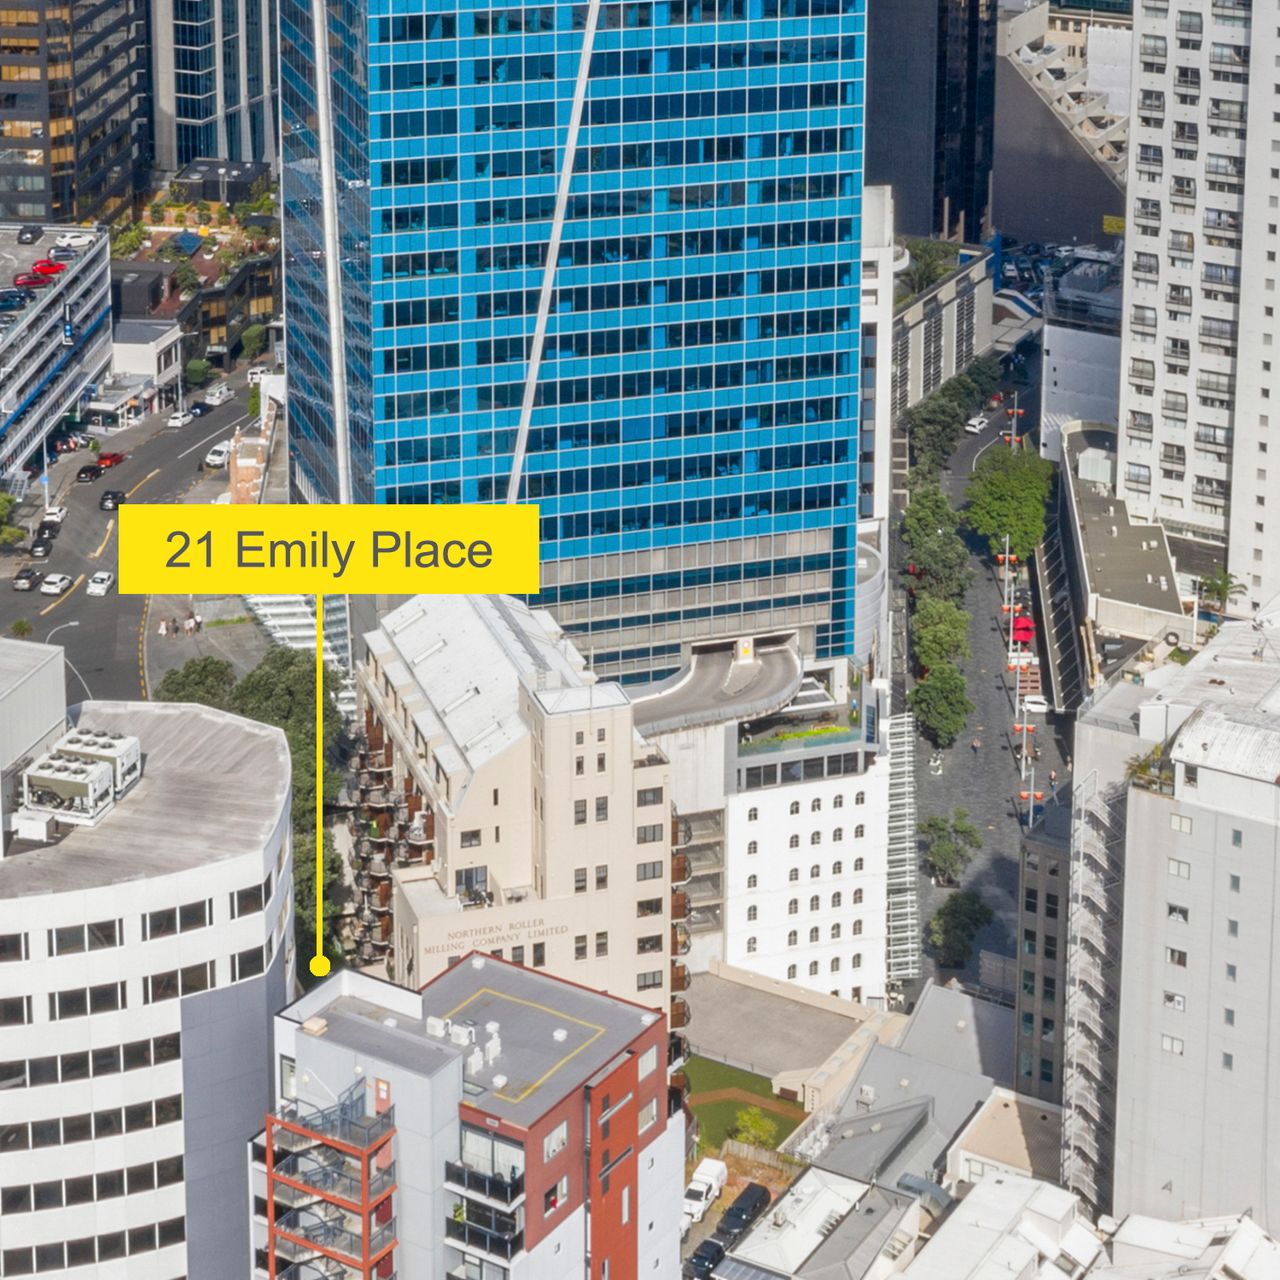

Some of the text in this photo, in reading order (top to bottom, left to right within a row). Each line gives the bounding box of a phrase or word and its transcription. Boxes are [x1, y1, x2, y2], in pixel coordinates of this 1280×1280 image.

[424, 925, 569, 955] MILLING COMPANY LIMITED
[448, 918, 545, 940] NORTHERN ROLLER
